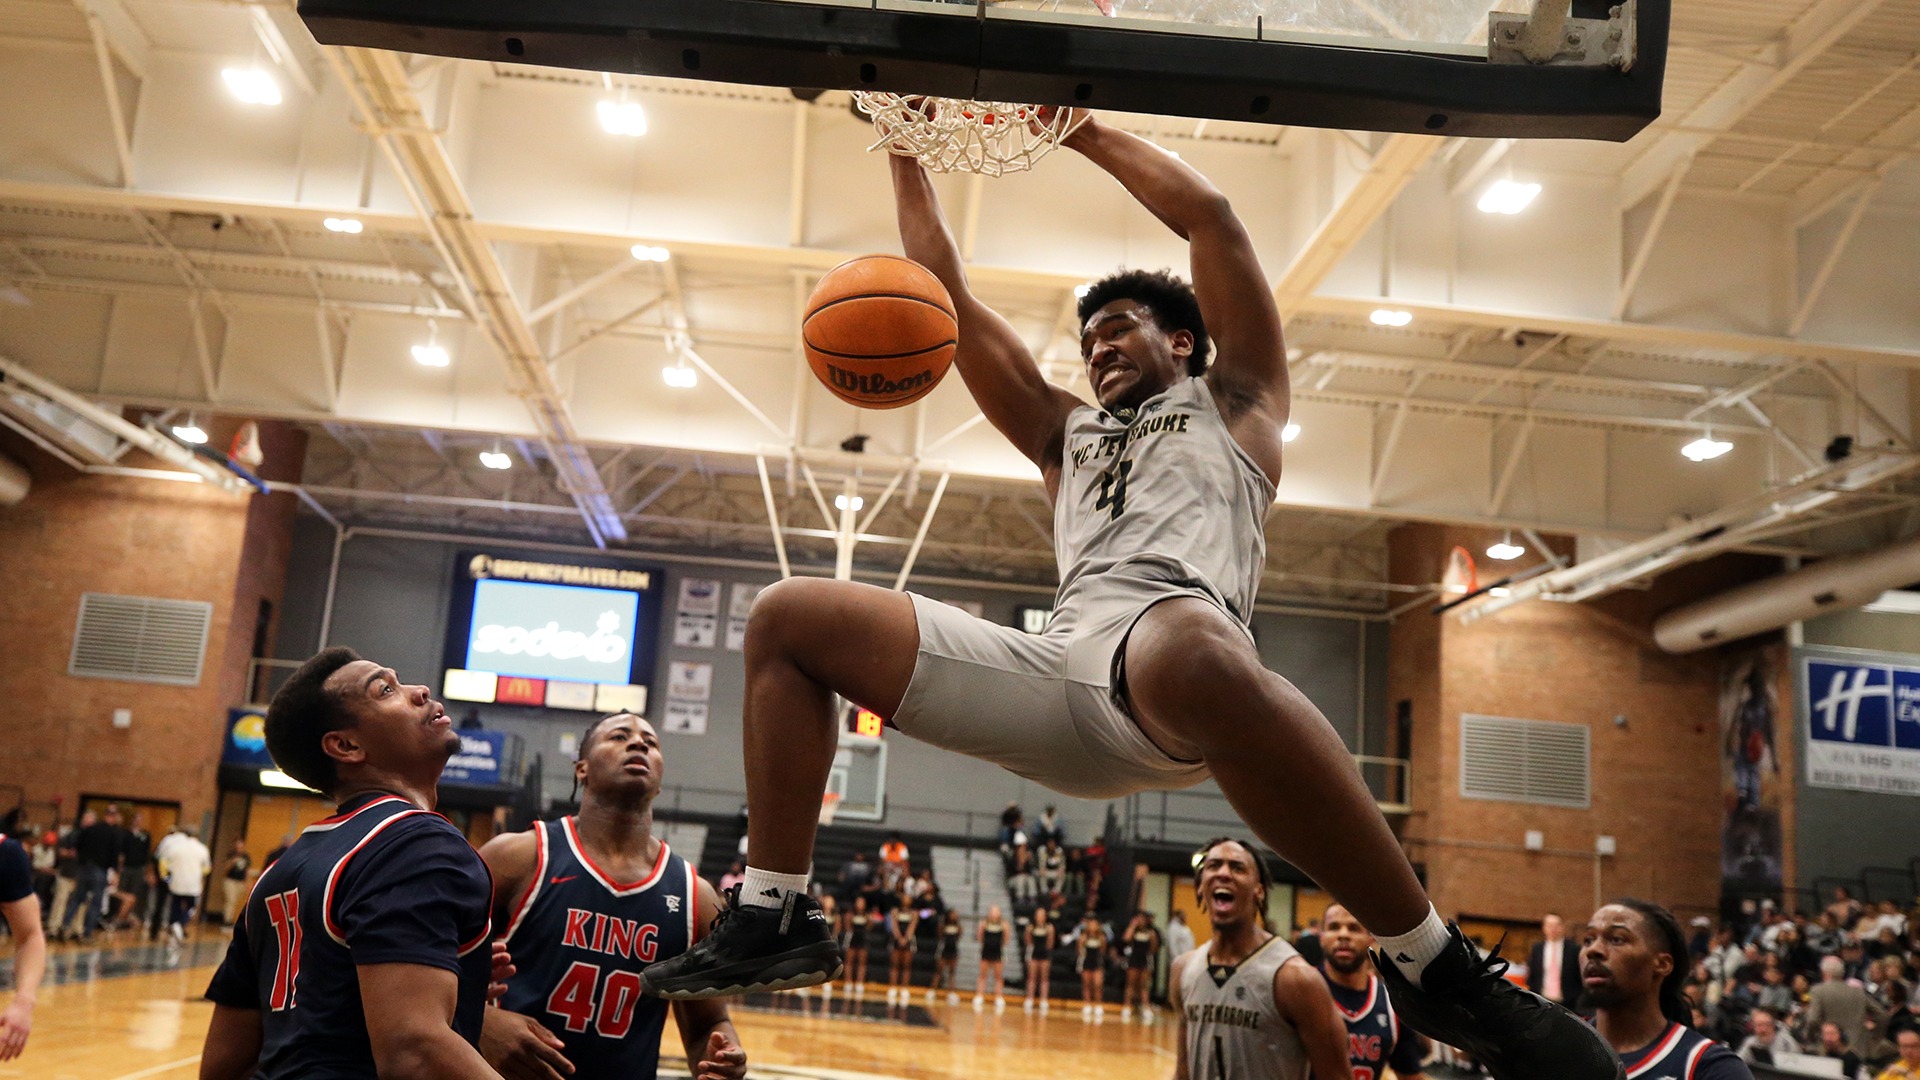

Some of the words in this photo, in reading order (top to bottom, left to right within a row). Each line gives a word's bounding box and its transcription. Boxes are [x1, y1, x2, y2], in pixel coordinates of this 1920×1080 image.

[826, 362, 932, 395] Wilson
[1095, 458, 1133, 521] 4
[265, 887, 303, 1012] 11
[561, 907, 660, 963] KING
[546, 960, 642, 1039] 40
[1348, 1032, 1382, 1061] NG
